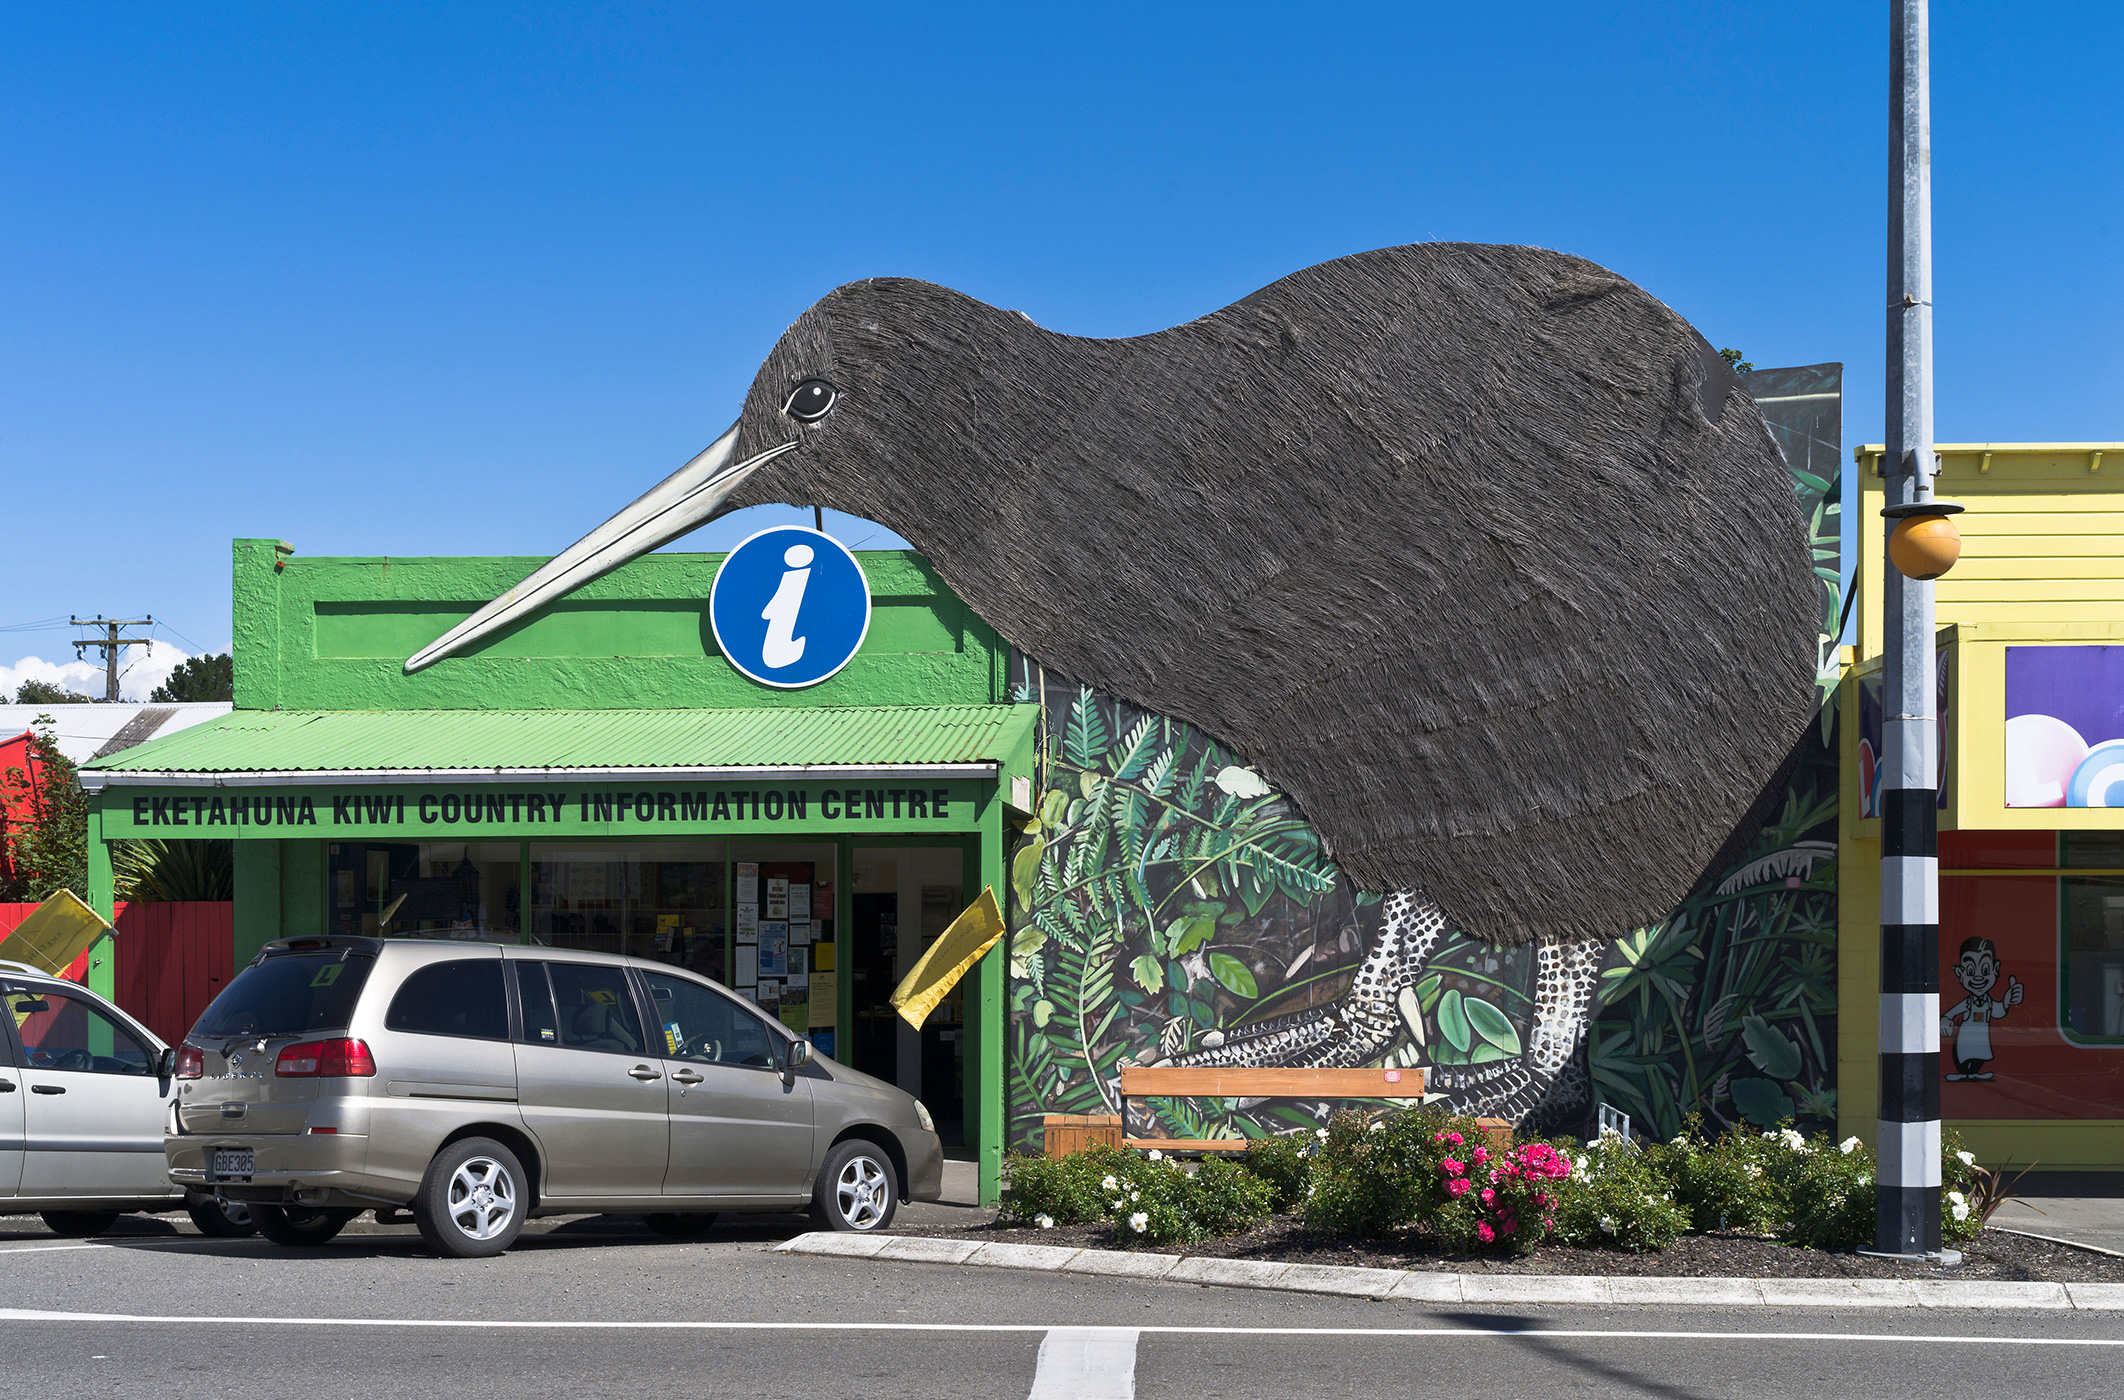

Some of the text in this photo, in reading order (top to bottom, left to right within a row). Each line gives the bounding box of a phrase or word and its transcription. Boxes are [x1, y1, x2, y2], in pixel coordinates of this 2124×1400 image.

[761, 544, 815, 669] i
[132, 788, 950, 826] EKETAHUNA KIWI COUNTRY INFORMATION CENTRE
[209, 1071, 264, 1080] LIBERTY
[215, 1154, 254, 1172] GBE305
